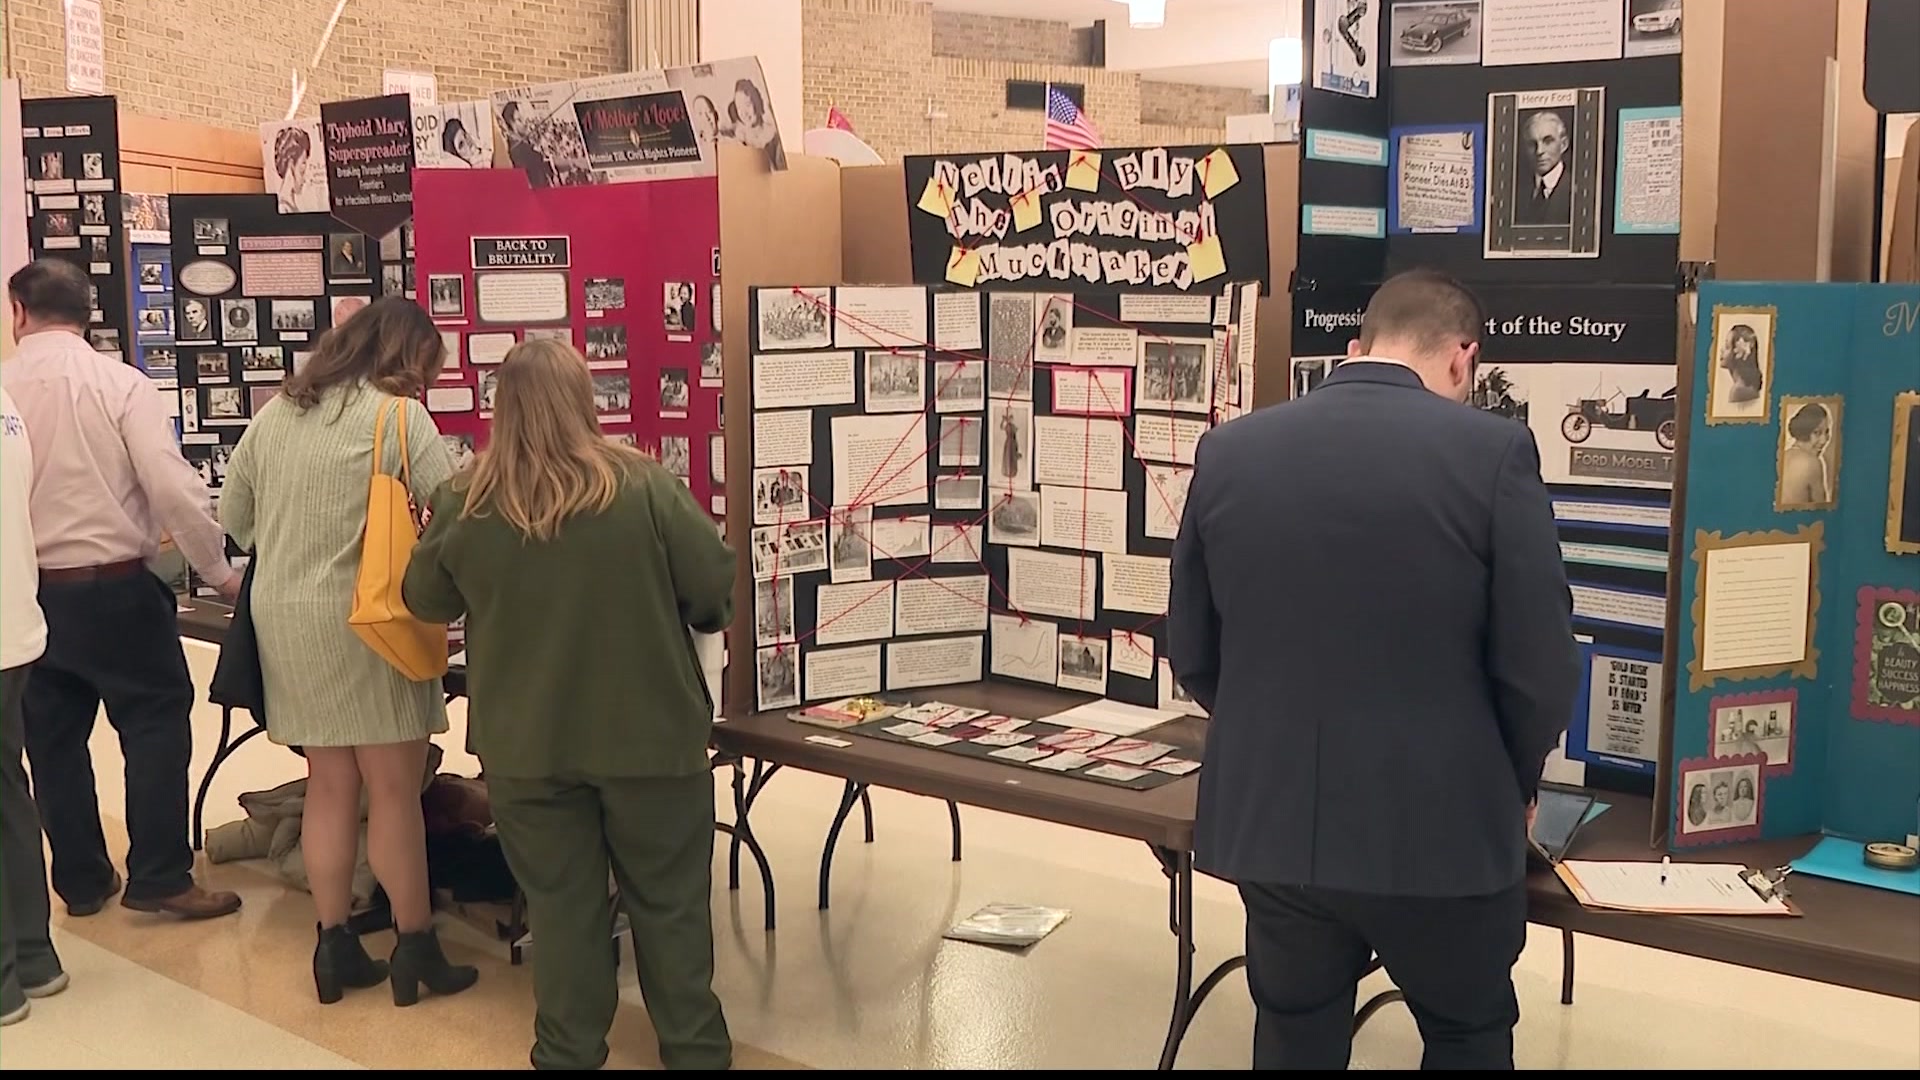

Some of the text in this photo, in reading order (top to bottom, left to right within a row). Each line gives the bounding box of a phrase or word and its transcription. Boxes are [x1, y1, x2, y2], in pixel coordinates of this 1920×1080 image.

[1522, 92, 1572, 105] Henry Ford
[327, 118, 372, 143] Typhoid
[375, 117, 408, 138] Mary,
[628, 150, 644, 161] Civil
[645, 149, 668, 162] Rights
[669, 147, 698, 159] Pioneer
[337, 166, 361, 179] Breaking
[361, 165, 383, 178] Through
[384, 162, 405, 174] Medical
[1120, 156, 1189, 187] Bly
[1405, 160, 1427, 174] Henry
[1450, 164, 1468, 176] Auto
[359, 179, 385, 191] Frontiers
[940, 164, 1058, 191] Nellie
[1434, 175, 1449, 187] Dies
[1450, 177, 1458, 188] At
[1460, 177, 1470, 189] 83
[951, 204, 1006, 230] The
[1056, 204, 1212, 237] Original
[243, 239, 282, 249] TYPHOID
[496, 240, 548, 251] BACK TO
[488, 253, 556, 265] BRUTALITY
[978, 247, 1189, 280] Muckraker
[1501, 315, 1525, 335] of
[1528, 315, 1562, 335] the
[1569, 316, 1626, 342] Story
[1573, 451, 1672, 470] FORD MODEL T
[1884, 657, 1918, 669] BEAUTY
[1609, 673, 1648, 689] IS STARTED
[1881, 669, 1919, 681] SUCCESS
[1608, 686, 1647, 702] BY FORD'S
[1878, 681, 1920, 694] HAPPINESS
